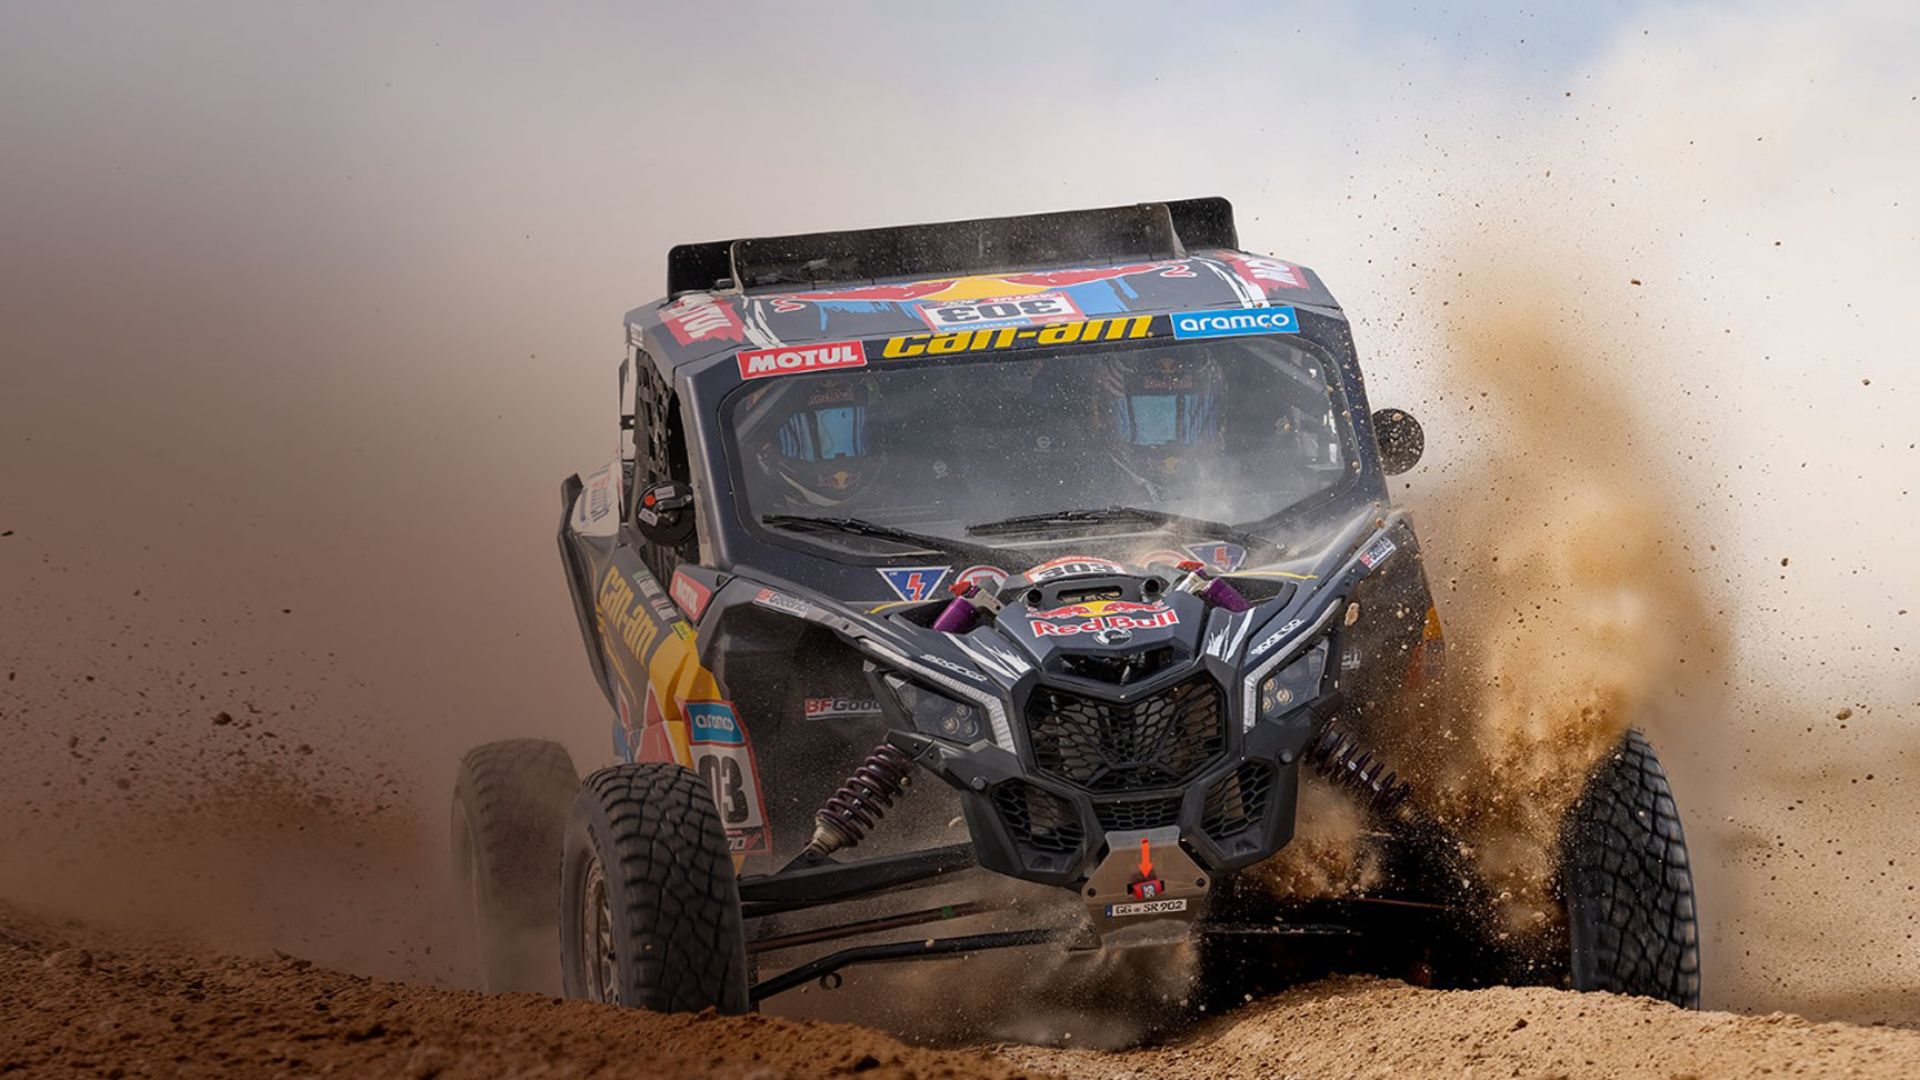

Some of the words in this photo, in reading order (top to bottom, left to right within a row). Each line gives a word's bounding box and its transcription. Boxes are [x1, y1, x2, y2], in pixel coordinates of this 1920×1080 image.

[937, 299, 1062, 323] 303
[1179, 312, 1290, 332] aramco
[882, 315, 1153, 358] can-am
[747, 346, 859, 373] MOTUL
[1038, 562, 1117, 580] 303
[1030, 617, 1105, 638] Red
[1107, 609, 1180, 630] Bull
[695, 714, 735, 732] aramco
[1160, 900, 1184, 911] 902
